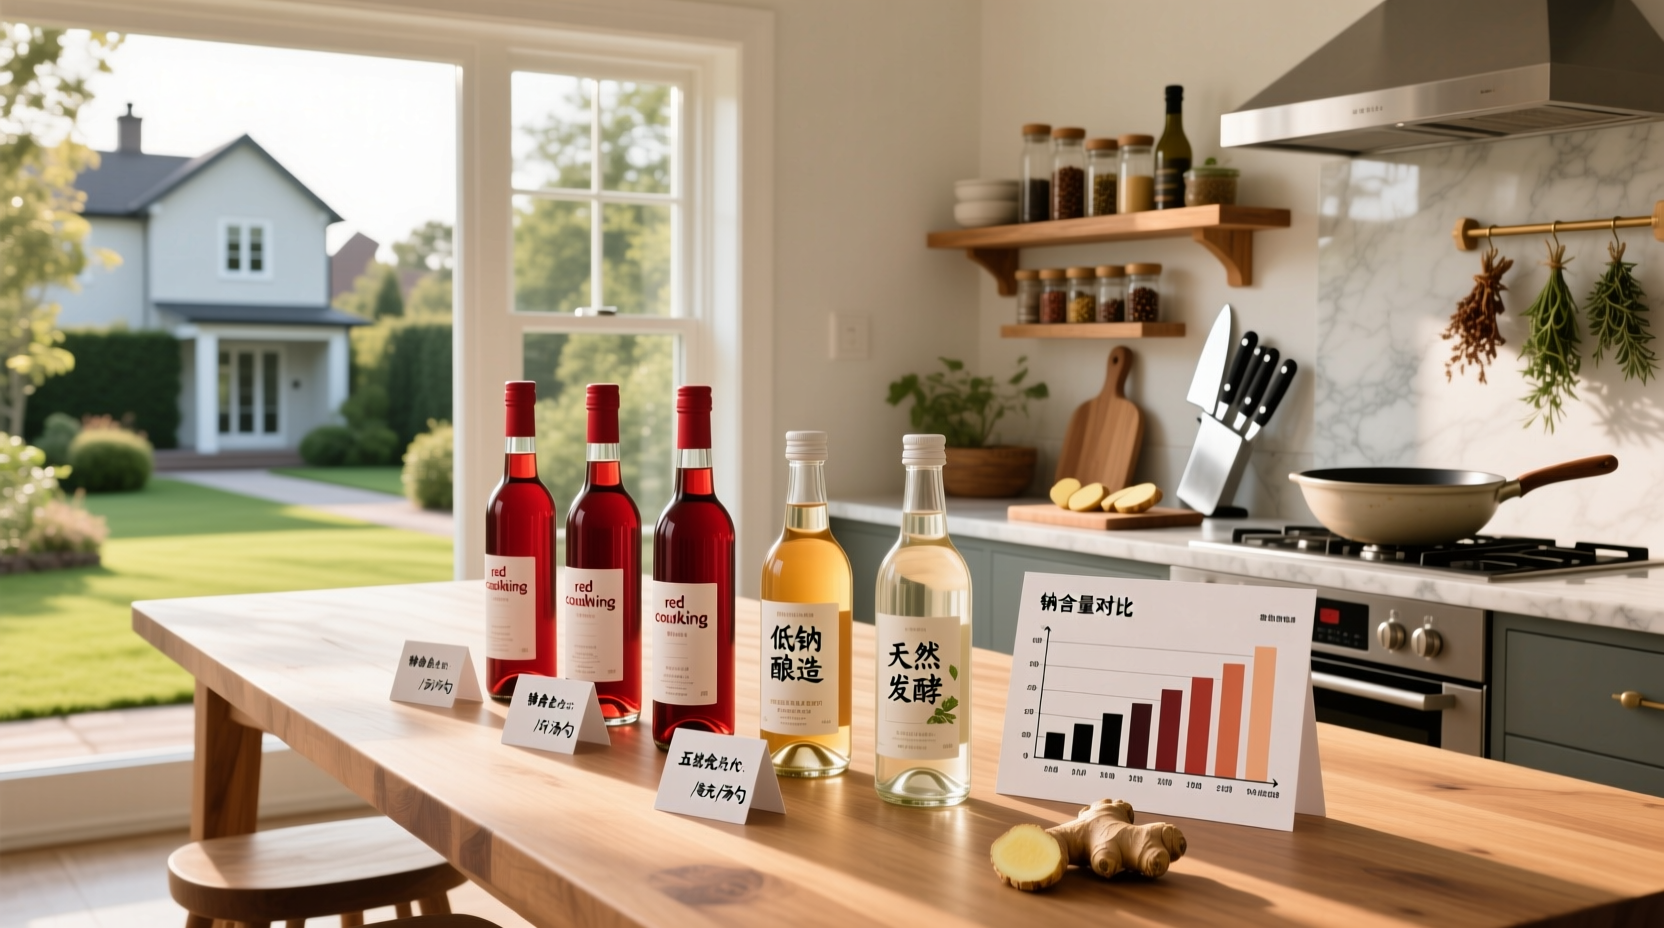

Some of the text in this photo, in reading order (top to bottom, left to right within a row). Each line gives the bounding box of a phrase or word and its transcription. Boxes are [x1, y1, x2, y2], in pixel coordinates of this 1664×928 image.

[491, 566, 506, 577] red
[575, 580, 593, 592] red
[665, 595, 685, 608] red
[1040, 592, 1134, 617] 钠含量对比
[770, 625, 822, 652] 低钠
[888, 641, 940, 670] 天然
[770, 655, 824, 684] 酿造
[888, 673, 943, 705] 发酵
